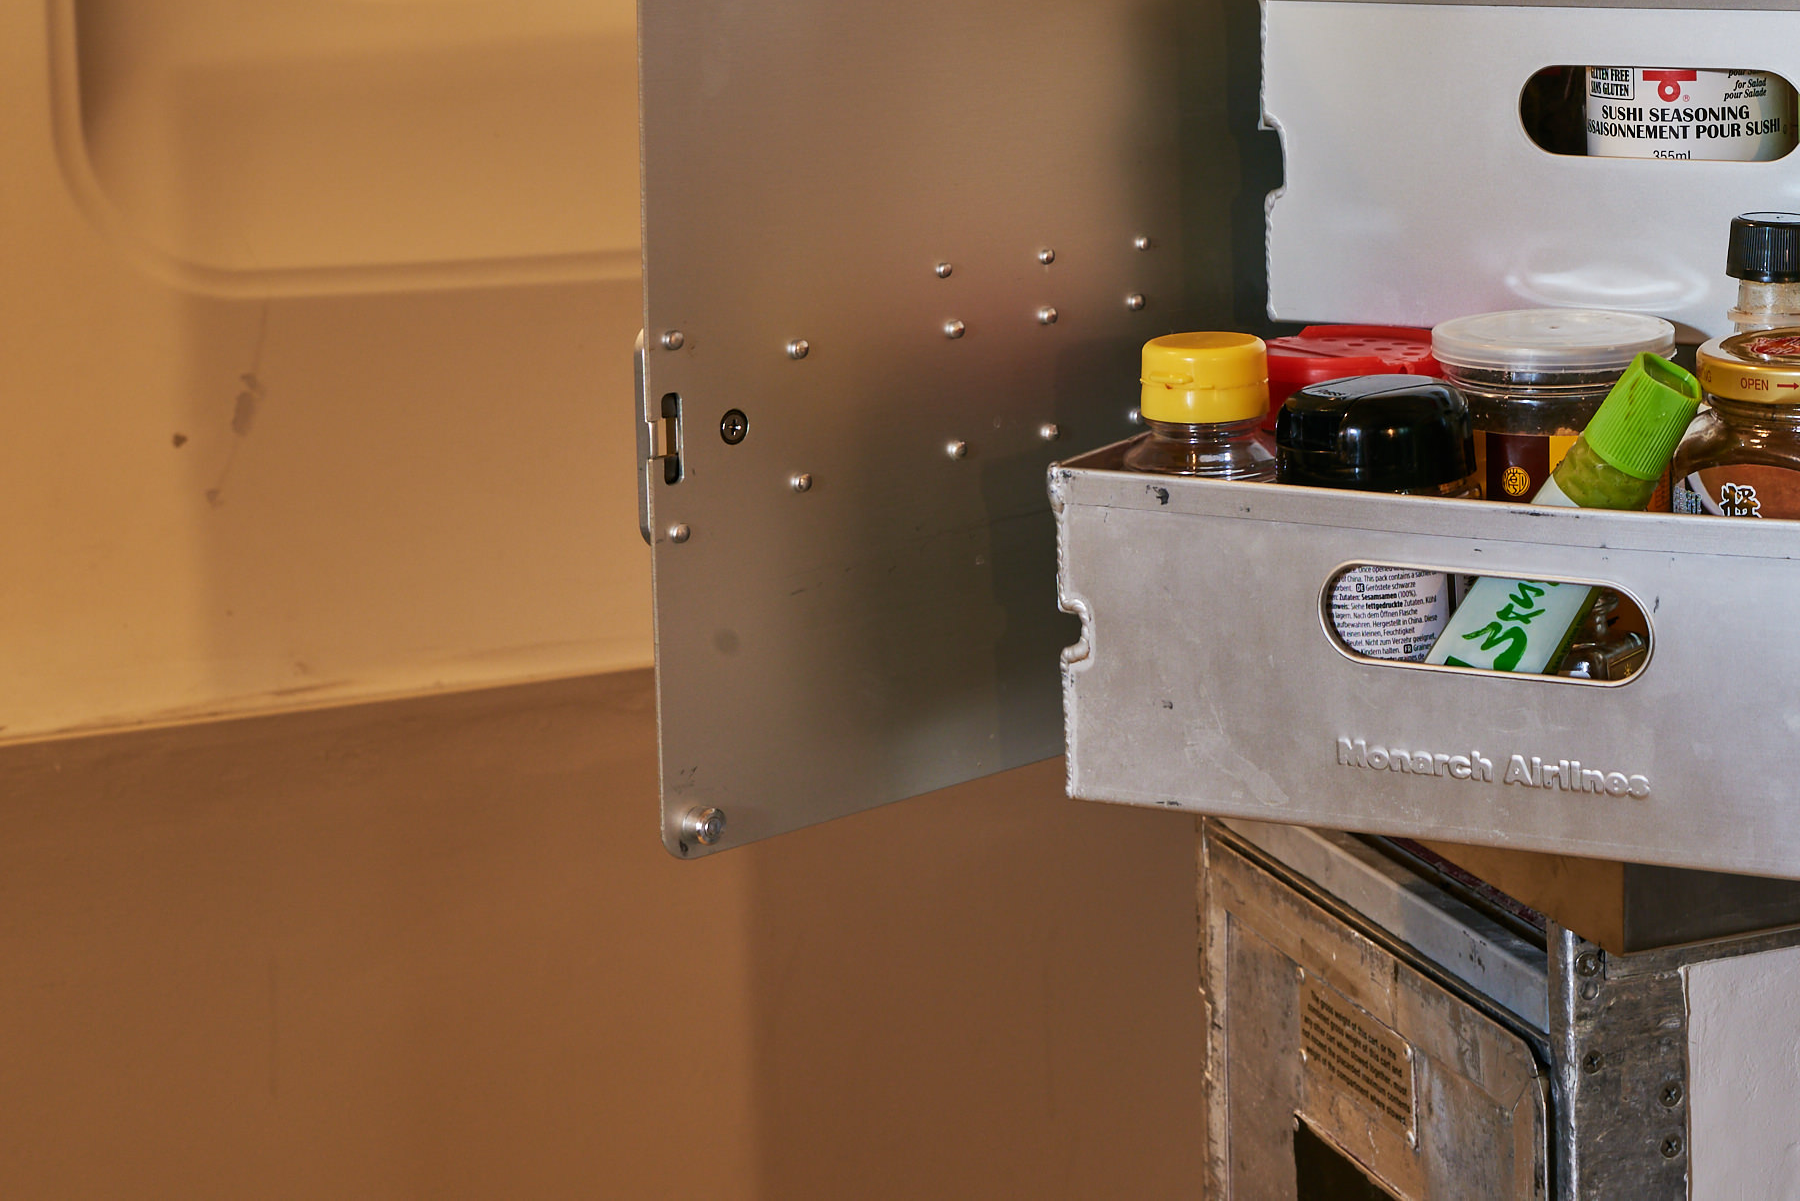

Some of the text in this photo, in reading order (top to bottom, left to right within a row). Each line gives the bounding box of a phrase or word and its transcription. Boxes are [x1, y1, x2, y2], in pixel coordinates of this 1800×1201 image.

[1611, 69, 1629, 82] FREE
[1591, 81, 1629, 96] SANS GLUTEN
[1734, 78, 1766, 91] for Salad
[1724, 88, 1767, 101] pour Salade
[1602, 105, 1750, 122] SUSHI SEASONING
[1587, 118, 1780, 139] SSAISONNEMENT POUR SUSHI
[1653, 150, 1690, 159] 355ml
[1741, 377, 1769, 391] OPEN
[1375, 574, 1388, 582] pack
[1389, 572, 1410, 580] contains
[1392, 581, 1416, 589] schwarze
[1362, 592, 1397, 600] Sesamsamen
[1365, 601, 1403, 610] fettgedruckte
[1372, 619, 1401, 628] Hergestellt
[1383, 627, 1415, 636] Feuchtigkeit
[1337, 737, 1650, 800] Monarch Airlines
